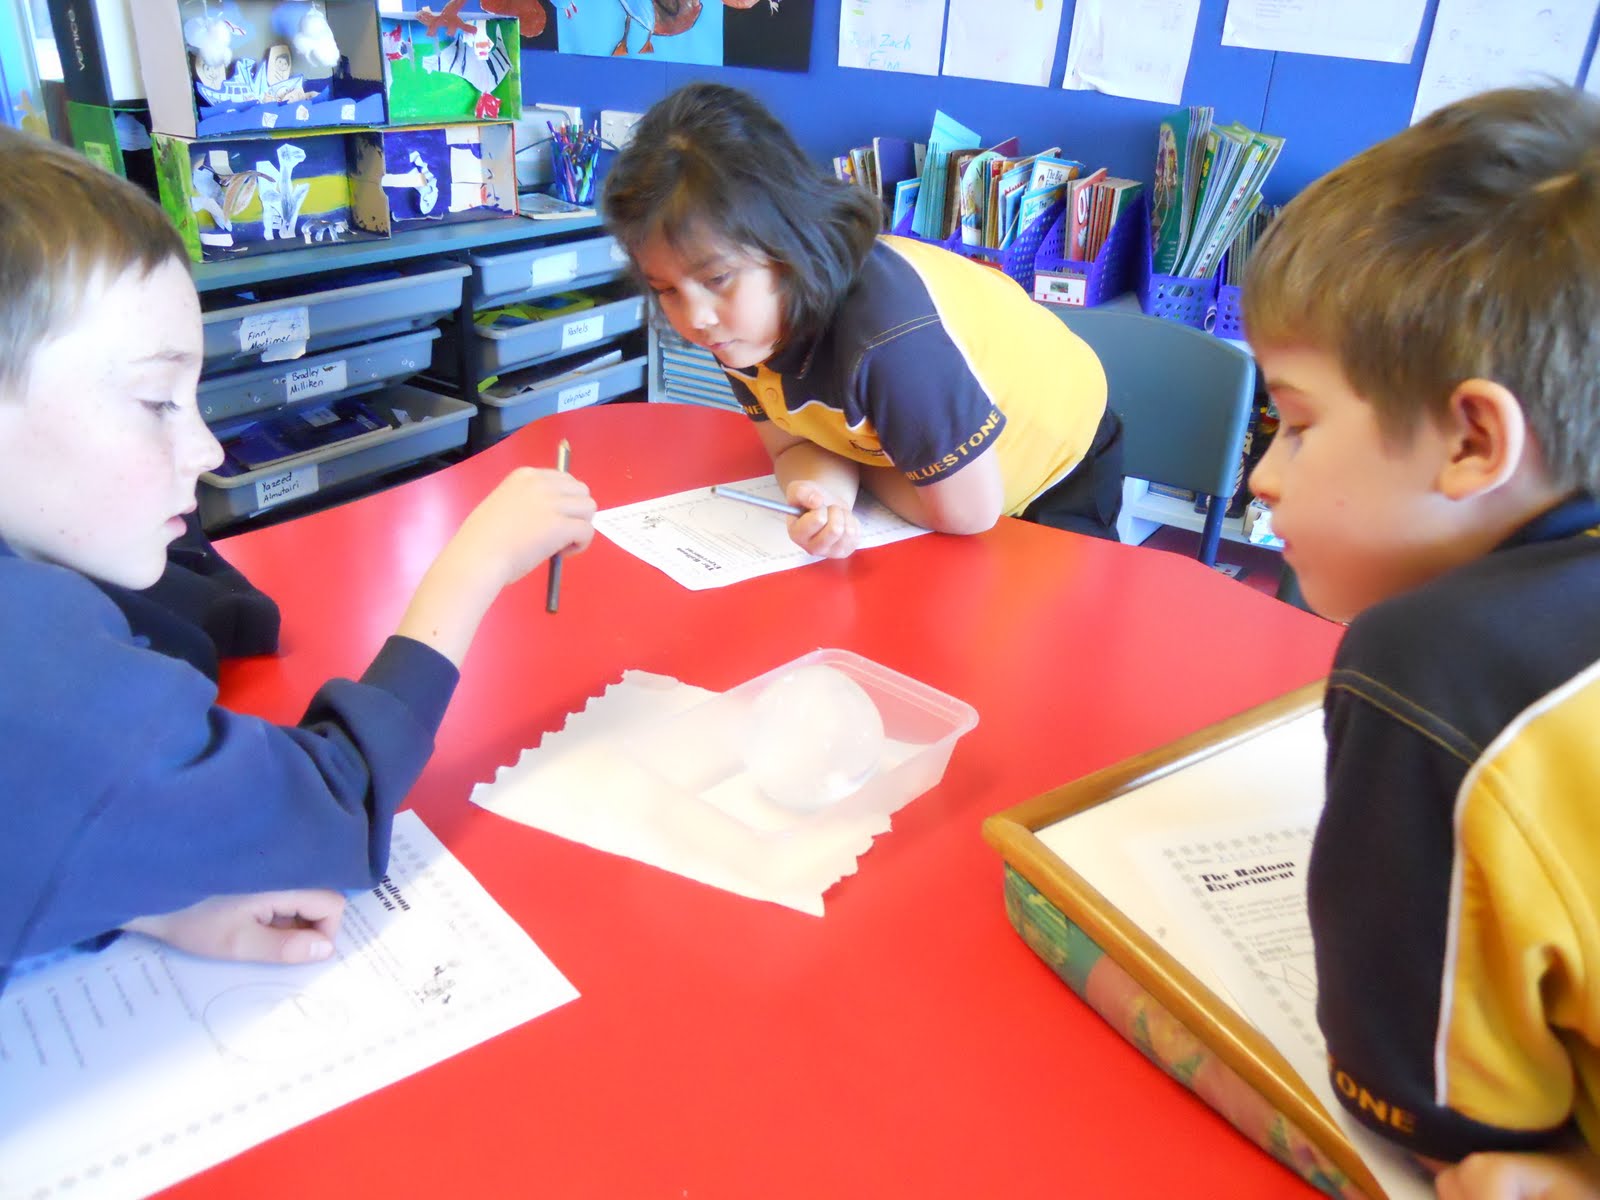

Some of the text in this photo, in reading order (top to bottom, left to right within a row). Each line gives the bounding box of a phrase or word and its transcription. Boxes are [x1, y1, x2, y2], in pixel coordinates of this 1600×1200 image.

[247, 330, 267, 342] Finn
[248, 334, 291, 352] Mortimer
[291, 367, 320, 382] Bradley
[290, 379, 324, 395] Milliken
[905, 409, 1001, 482] BLUESTONE
[261, 471, 293, 493] Yazeed
[263, 480, 300, 503] Almutairi
[1200, 860, 1296, 883] The Balloon
[1205, 871, 1295, 893] Experiment
